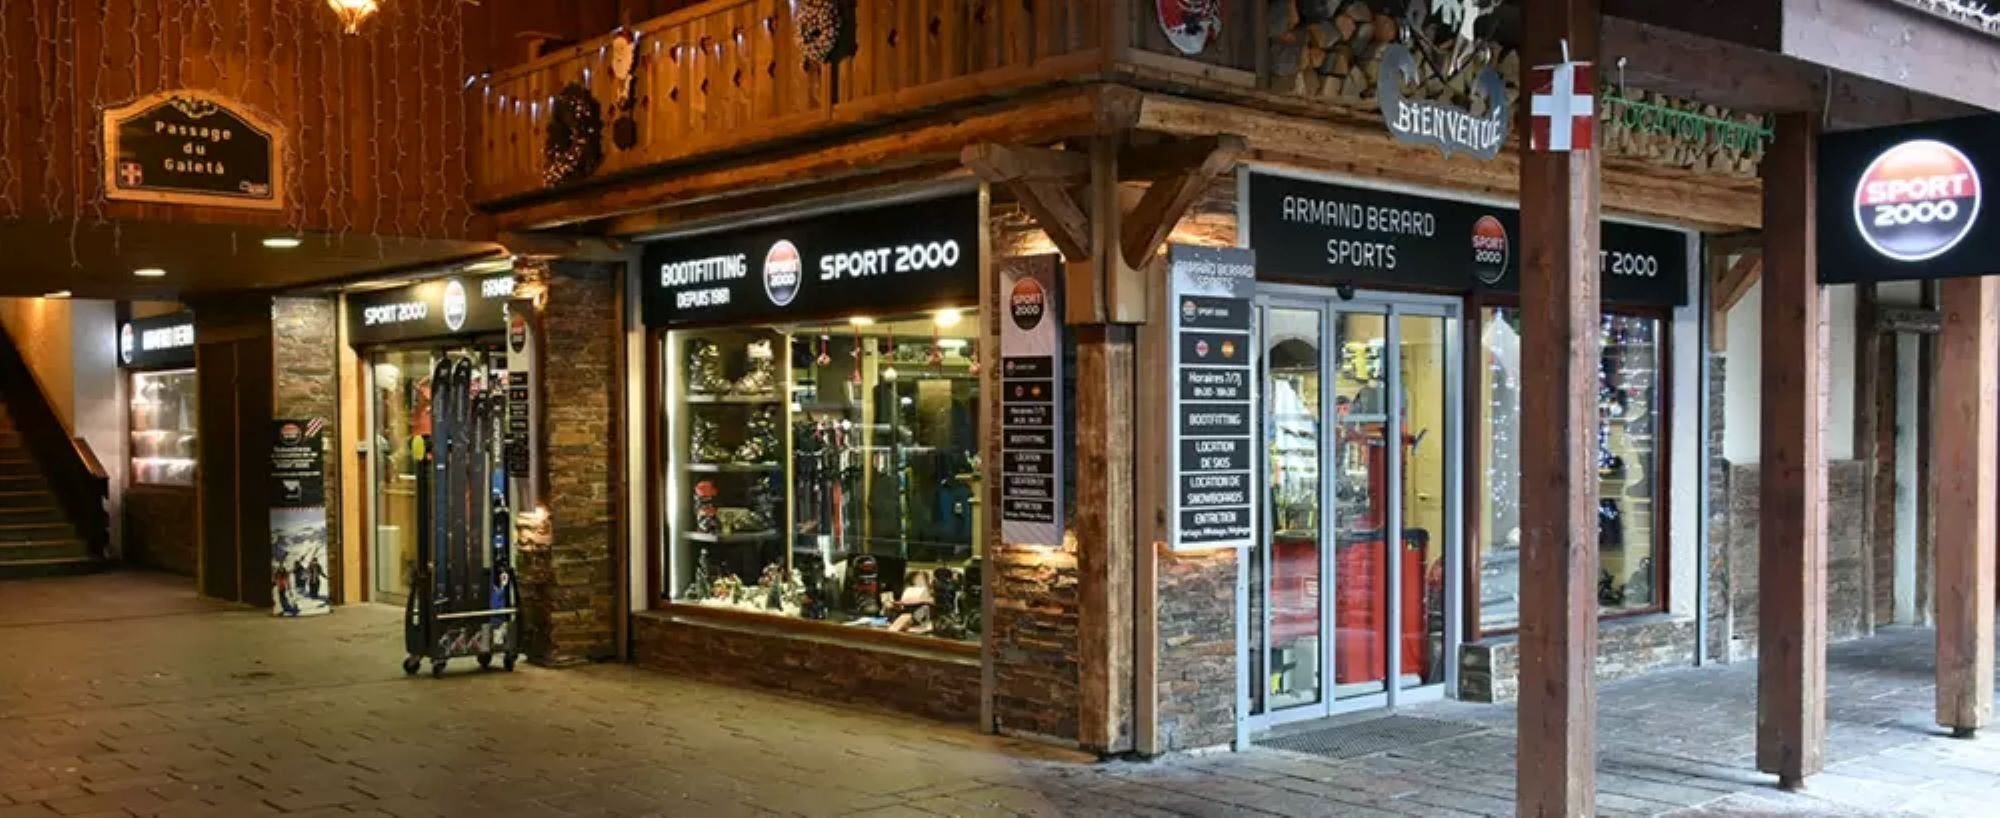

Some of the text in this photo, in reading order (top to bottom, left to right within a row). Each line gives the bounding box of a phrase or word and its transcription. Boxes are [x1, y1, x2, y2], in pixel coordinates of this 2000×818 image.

[155, 120, 232, 142] Passage
[1392, 101, 1501, 150] BIENVENUE
[183, 142, 206, 155] du
[1866, 172, 1970, 204] SPORT
[1283, 195, 1435, 237] ARMAND BERARD
[1874, 199, 1959, 227] 2000
[1472, 234, 1505, 250] SPORT
[820, 239, 960, 281] SPORT 2000
[1327, 238, 1396, 269] SPORTS
[1475, 249, 1502, 263] 2000
[661, 253, 747, 287] BOOTFITTING
[1612, 252, 1658, 277] 2000
[770, 273, 796, 287] 2000
[677, 290, 711, 309] DEPUIS
[364, 305, 398, 326] SPORT
[398, 301, 428, 322] 2000
[1015, 304, 1040, 316] 2000
[1188, 371, 1224, 384] Horaires
[1188, 412, 1242, 427] BOOTFITTING
[1194, 440, 1236, 453] LOCATION
[1188, 475, 1228, 489] LOCATION
